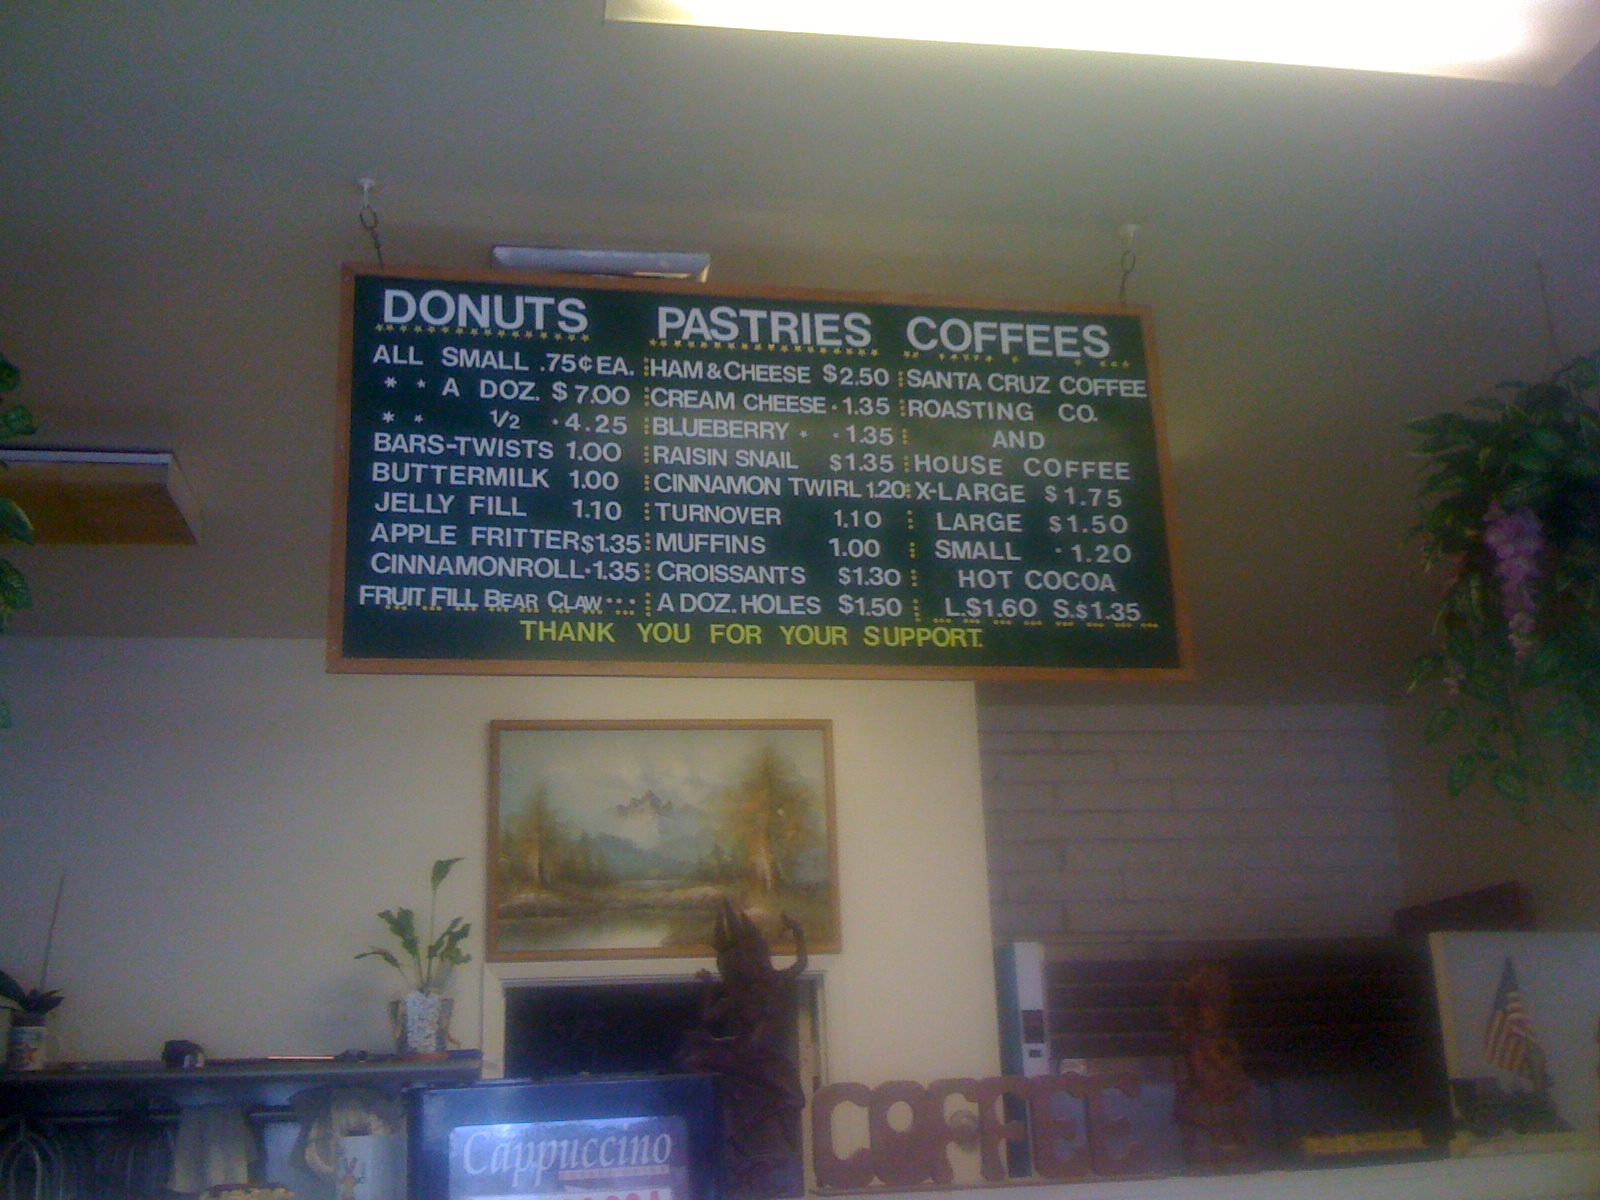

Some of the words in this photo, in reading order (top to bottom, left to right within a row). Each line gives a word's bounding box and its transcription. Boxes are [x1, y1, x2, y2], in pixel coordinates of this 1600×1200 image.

[383, 289, 588, 333] DONUTS
[657, 306, 872, 347] PASTRIES
[907, 316, 1111, 359] COFFEES
[372, 345, 424, 365] ALL
[442, 347, 529, 371] SMALL
[822, 363, 889, 387] $2.50
[907, 368, 982, 390] SANTA
[987, 373, 1051, 395] CRUZ
[1059, 376, 1147, 398] COFFEE
[442, 377, 460, 397] A
[480, 380, 540, 401] DOZ.
[650, 387, 735, 411] CREAM
[743, 393, 827, 415] CHEESE
[908, 400, 1034, 422] ROASTING
[1058, 403, 1098, 423] CO.
[652, 416, 789, 441] BLUEBERRY
[992, 430, 1045, 450] AND
[565, 441, 622, 463] 1.00
[653, 445, 728, 468] RAISIN
[735, 449, 799, 470] SNAIL
[829, 453, 895, 475] $1.35
[372, 462, 550, 489] BUTTERMILK
[569, 470, 619, 491] 1.00
[914, 455, 1003, 476] HOUSE
[1023, 457, 1131, 481] COFFEE
[653, 473, 781, 496] CINNAMON
[787, 476, 862, 498] TWIRL
[865, 480, 906, 500] 1.20
[374, 492, 455, 515] JELLY
[469, 495, 527, 517] FILL
[572, 499, 622, 521] 1.10
[655, 502, 782, 526] TURNOVER
[833, 509, 882, 529] 1.10
[370, 522, 457, 546] APPLE
[936, 512, 1023, 533] LARGE
[656, 532, 766, 555] MUFFINS
[828, 538, 880, 558] 1.00
[935, 539, 1022, 561] SMALL
[657, 560, 806, 585] CROISSANTS
[838, 566, 901, 587] $1.30
[958, 569, 1013, 589] HOT
[1024, 569, 1117, 592] COCOA
[359, 585, 425, 607] FRUIT
[431, 586, 479, 608] FILL
[657, 593, 675, 612] A
[680, 592, 737, 614] DOZ.
[741, 595, 821, 616] HOLES
[838, 593, 902, 618] $1.50
[519, 620, 615, 643] THANK
[636, 621, 691, 644] YOU
[710, 623, 763, 646] FOR
[779, 624, 848, 646] YOUR
[463, 1131, 673, 1189] Cappuccino
